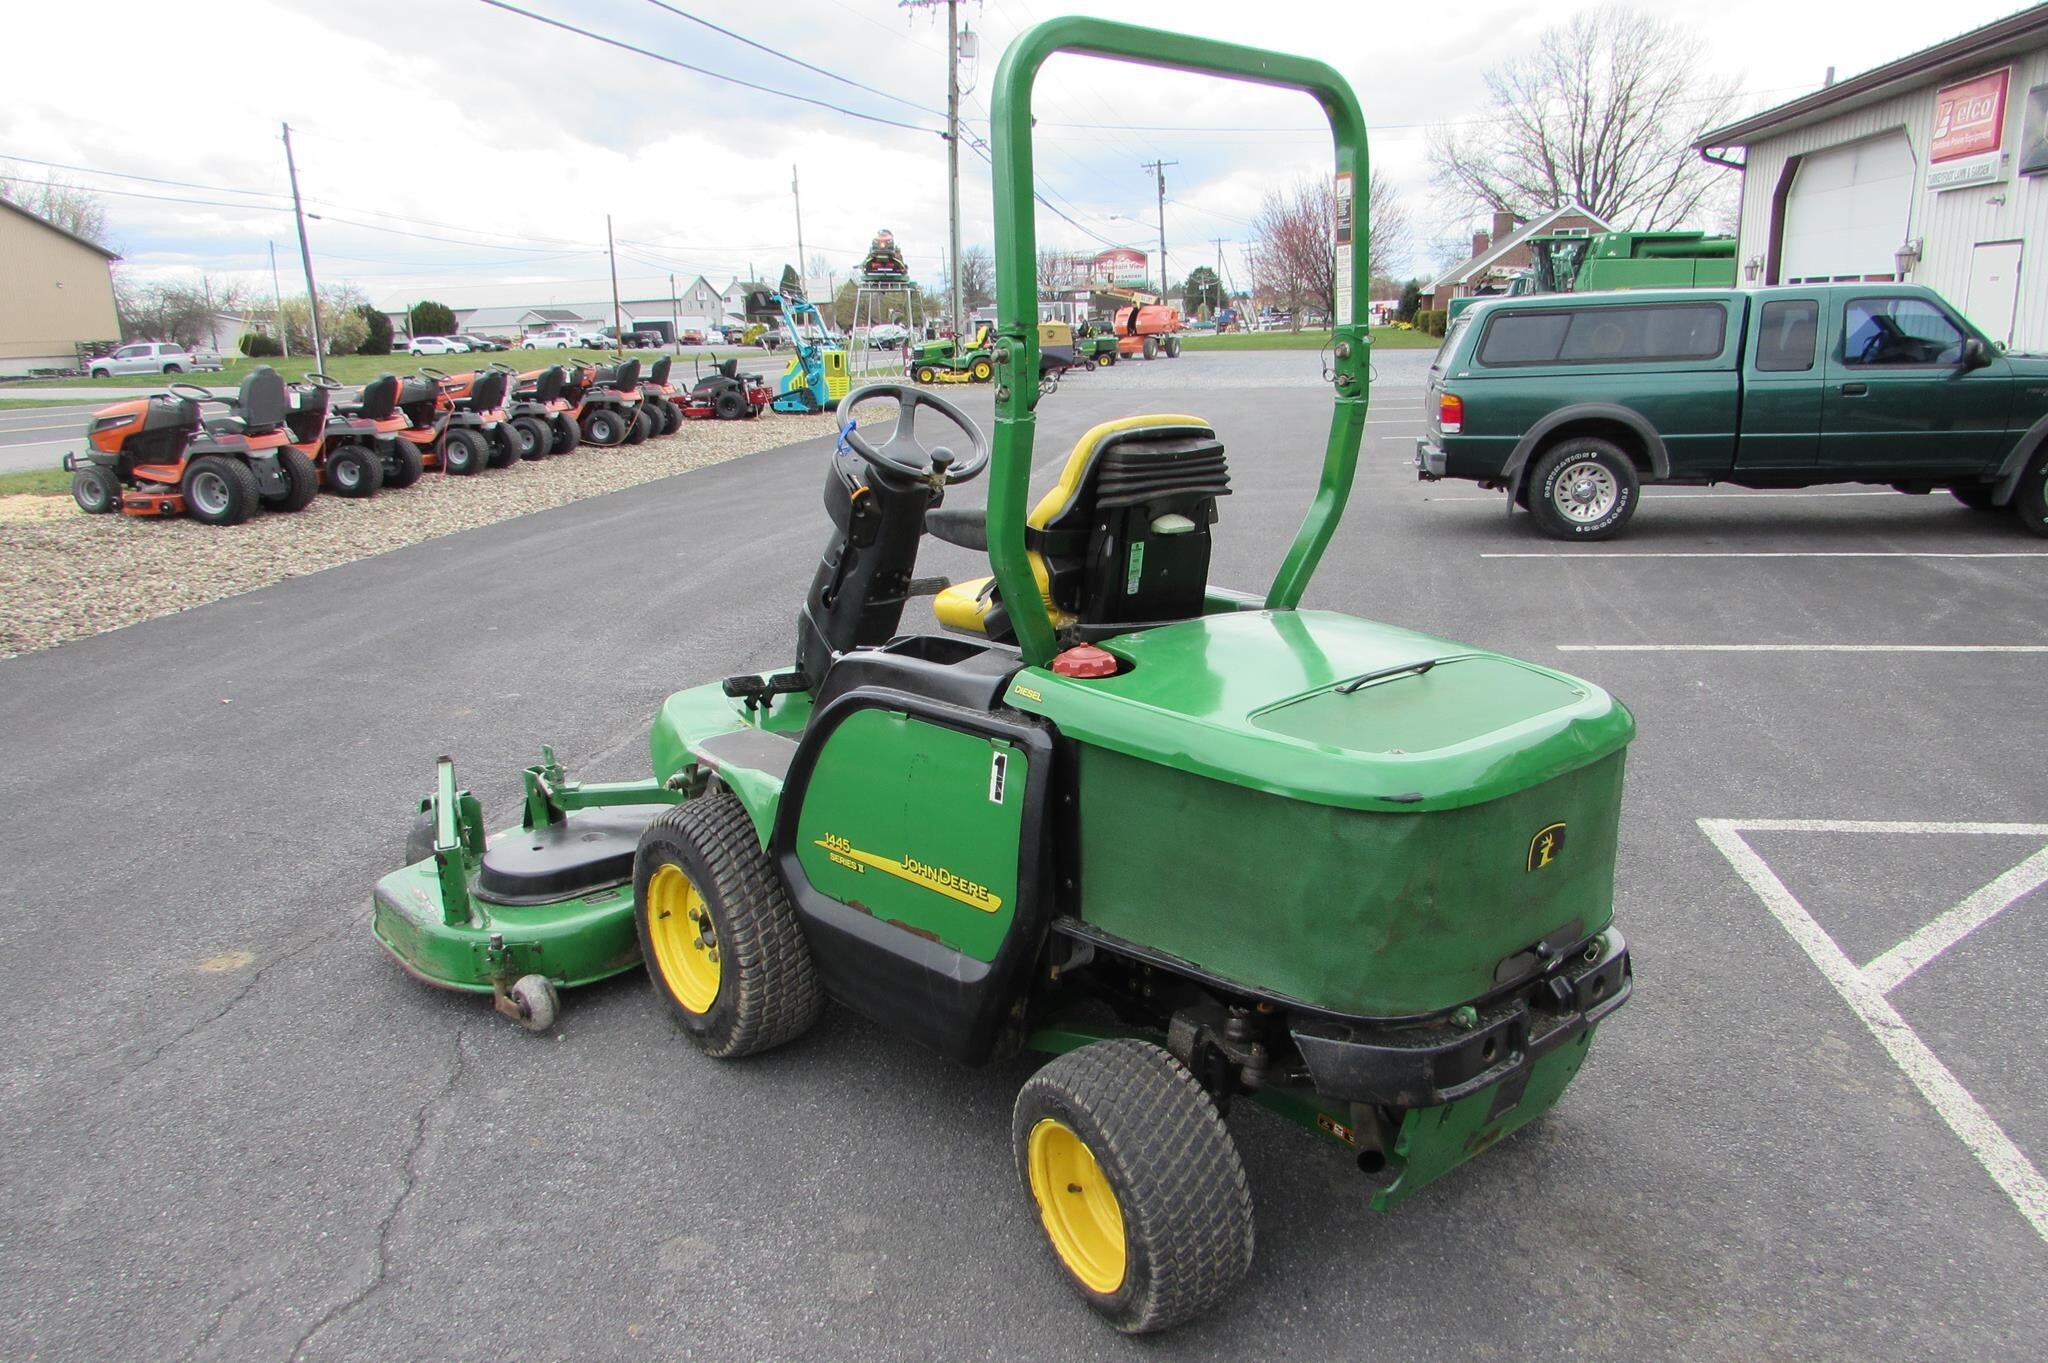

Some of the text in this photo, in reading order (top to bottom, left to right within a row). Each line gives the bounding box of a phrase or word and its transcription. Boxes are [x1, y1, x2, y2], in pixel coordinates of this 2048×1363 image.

[1015, 685, 1043, 703] DIESEL
[824, 832, 851, 853] 1445
[829, 852, 858, 870] SERIES
